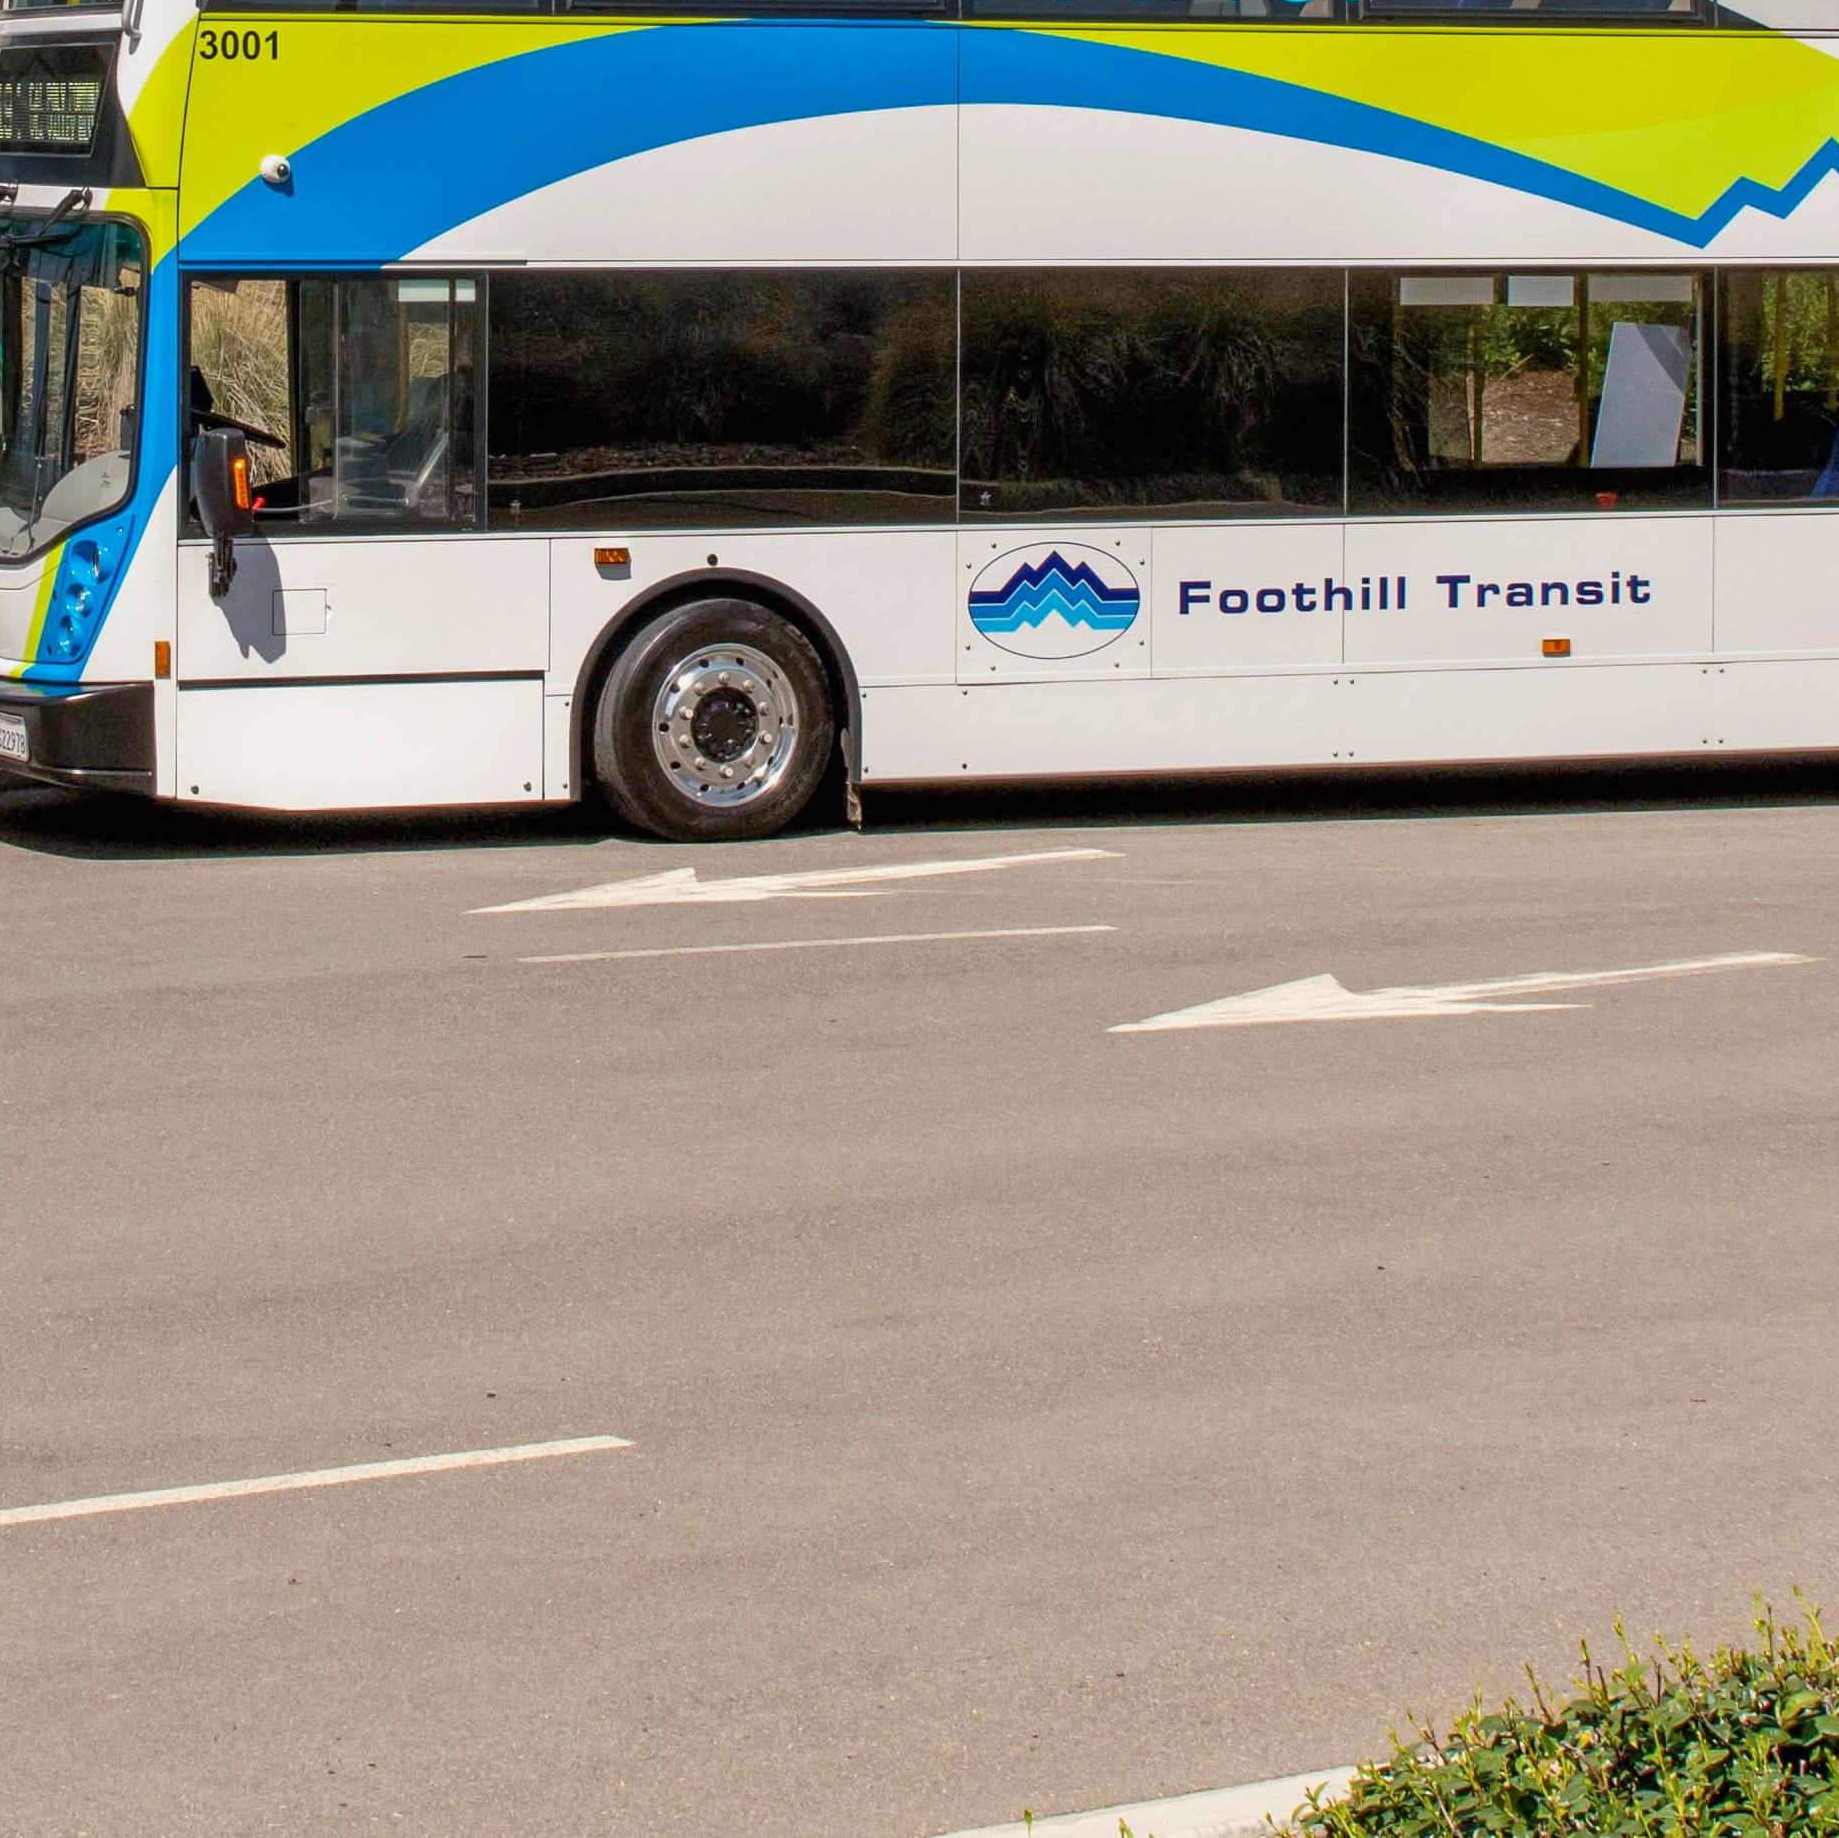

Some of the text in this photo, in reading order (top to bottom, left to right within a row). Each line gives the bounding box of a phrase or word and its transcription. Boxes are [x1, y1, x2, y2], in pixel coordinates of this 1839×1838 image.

[199, 30, 279, 61] 3001
[1179, 571, 1652, 616] Foothill Transit
